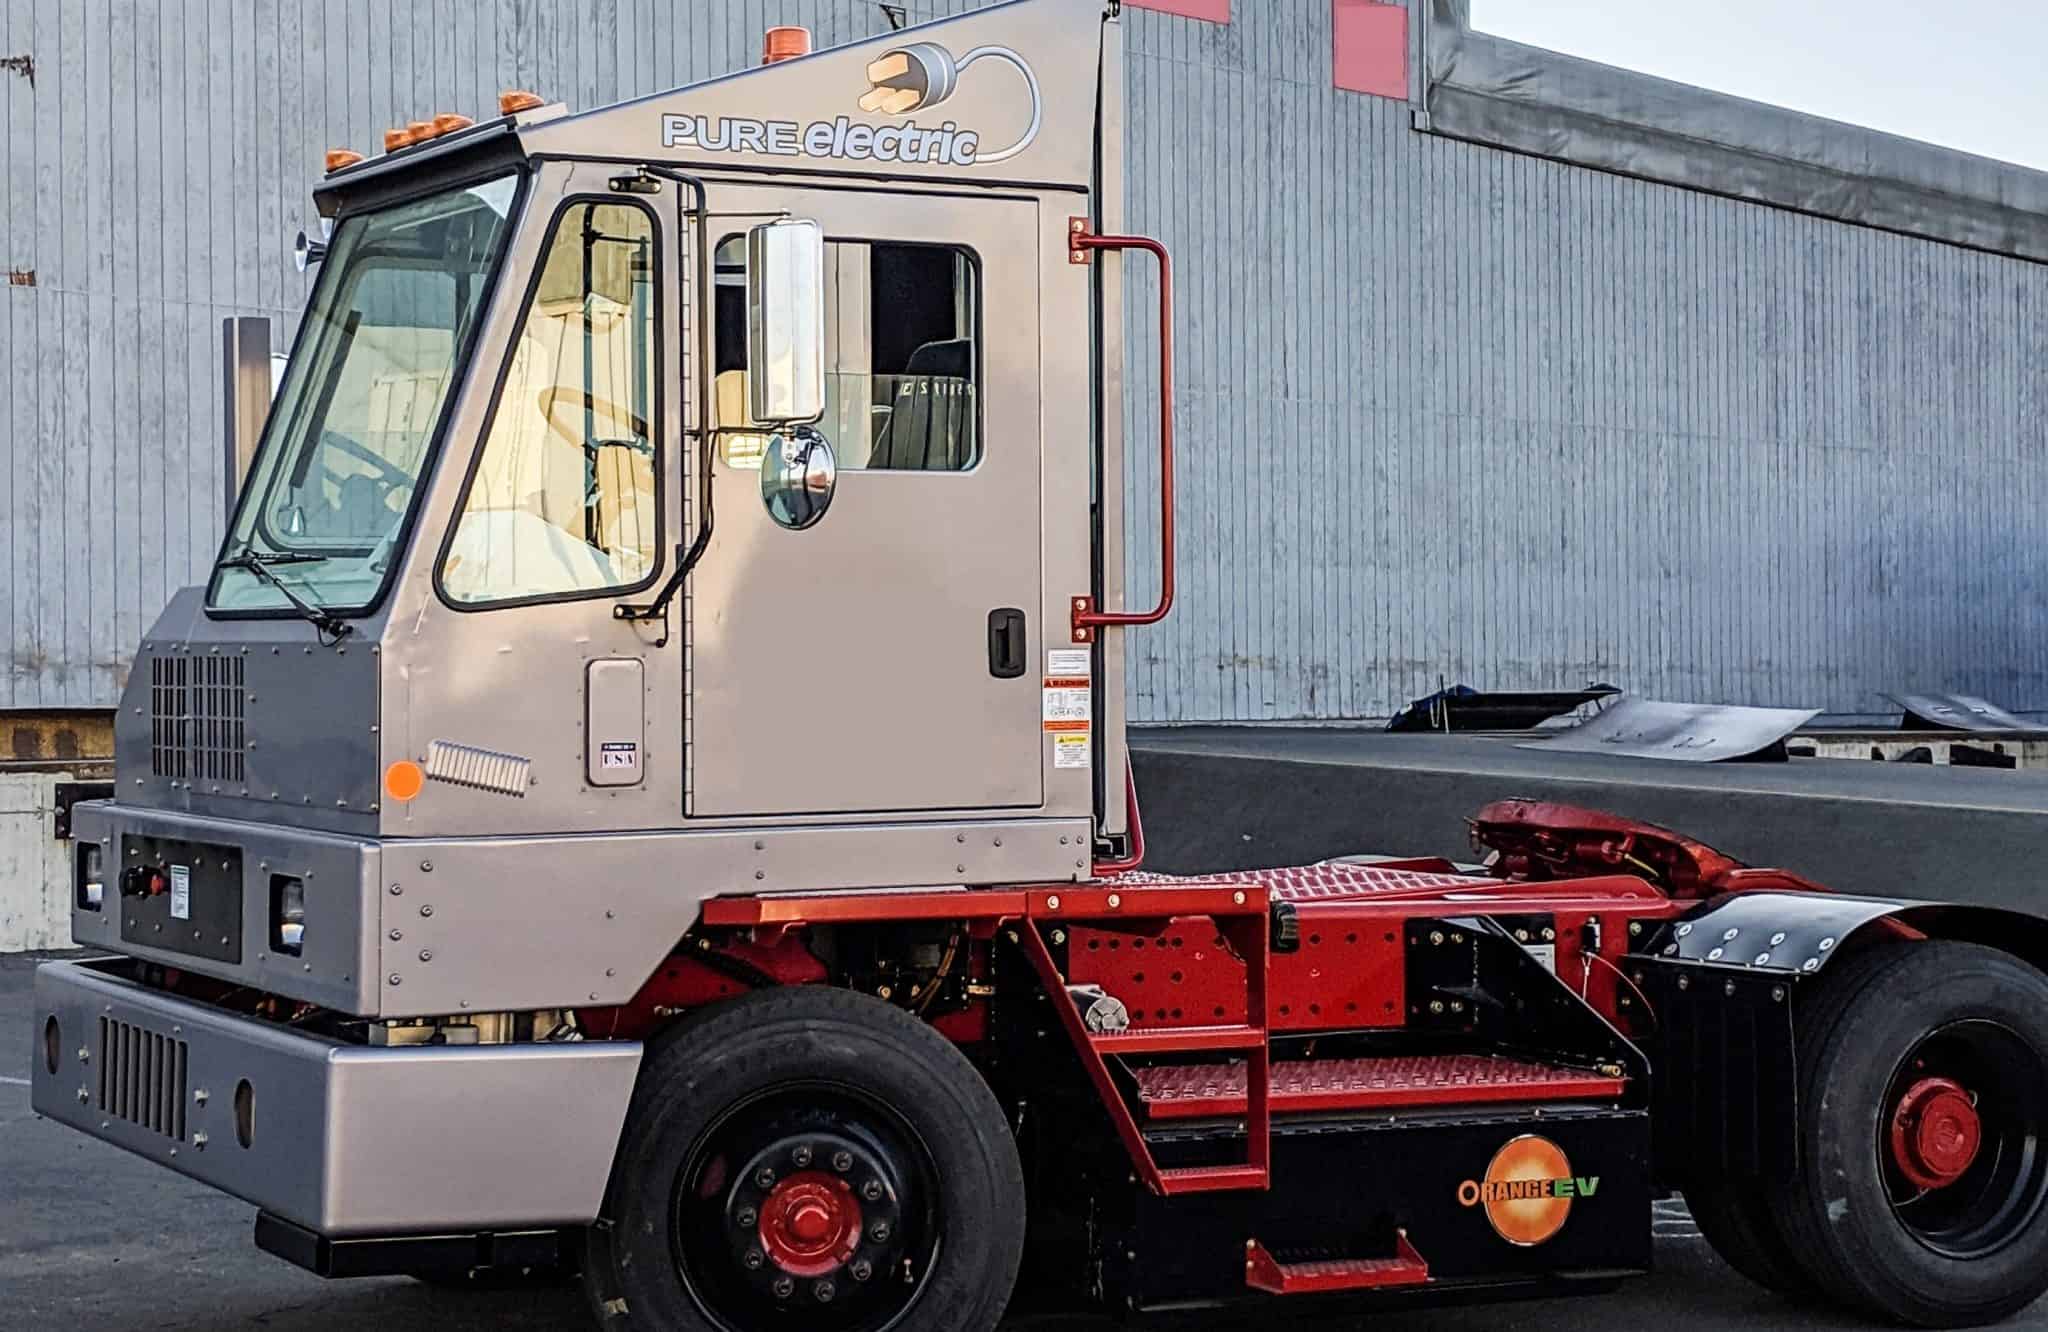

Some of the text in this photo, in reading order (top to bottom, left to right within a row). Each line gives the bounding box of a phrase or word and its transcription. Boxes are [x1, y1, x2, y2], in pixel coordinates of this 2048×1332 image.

[662, 114, 979, 166] PURE electric
[603, 753, 633, 765] USA
